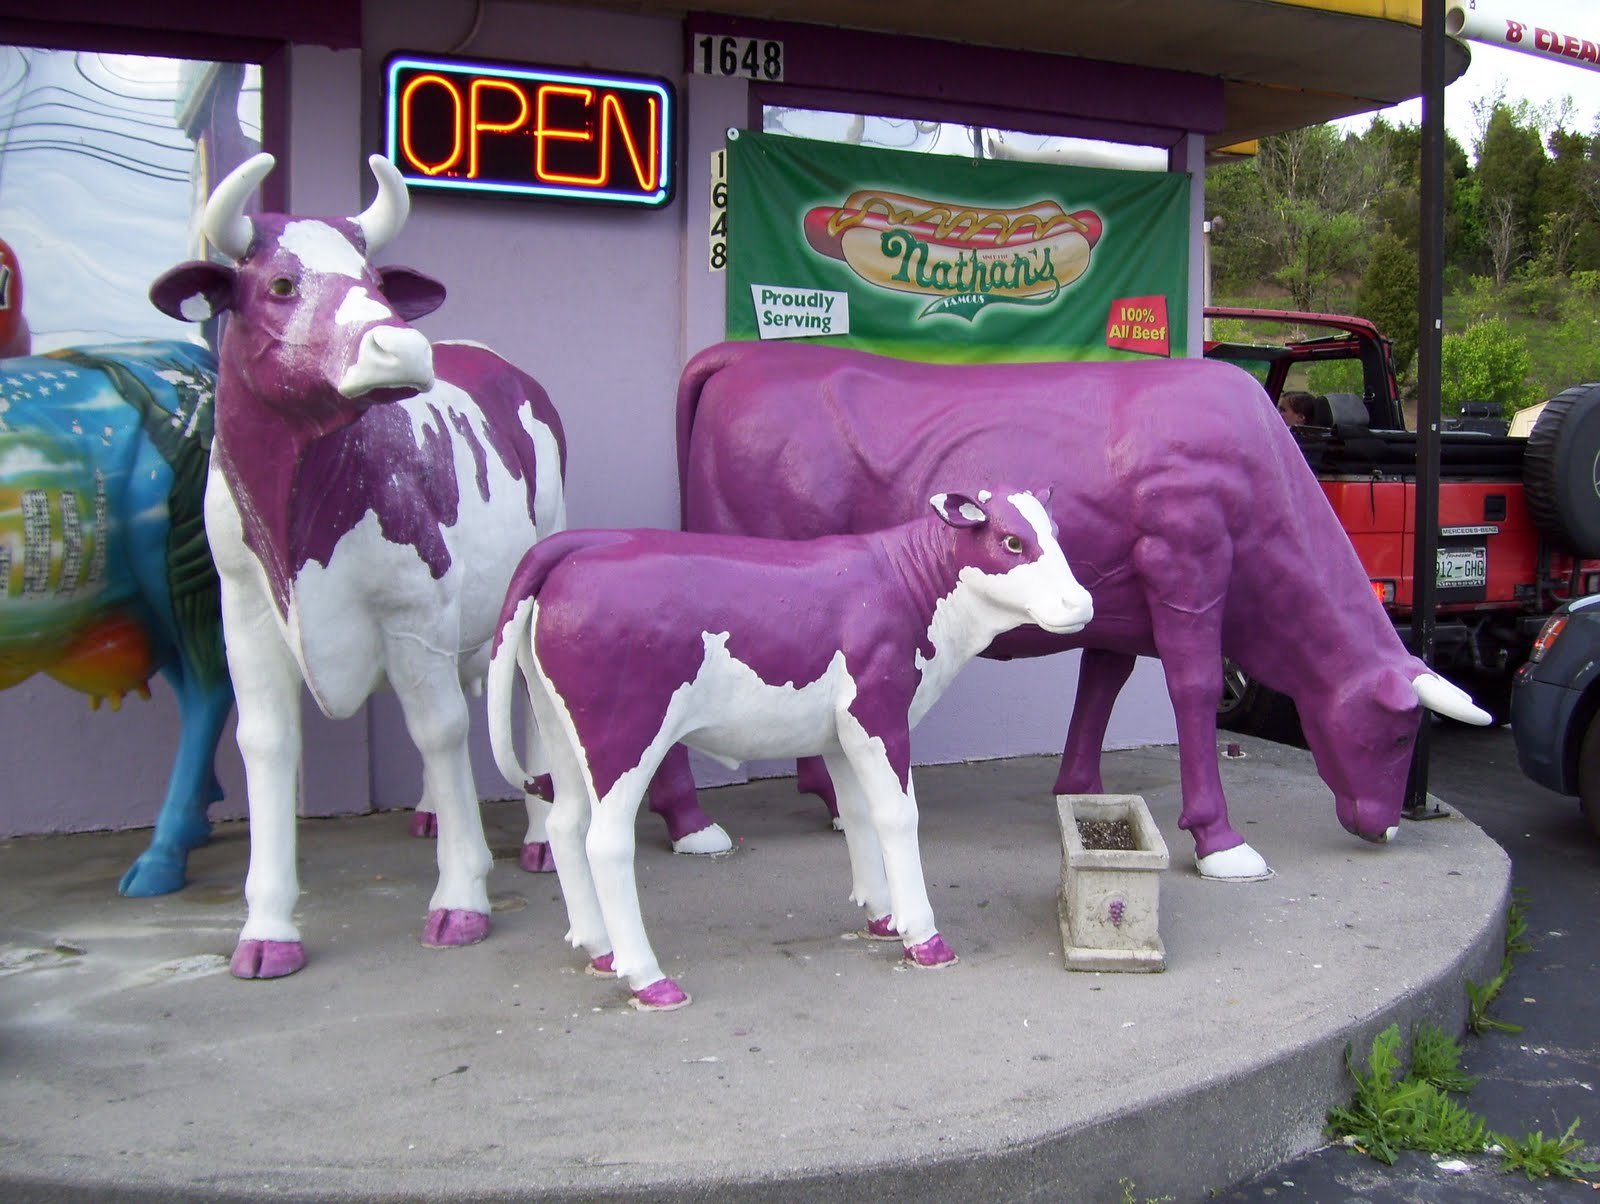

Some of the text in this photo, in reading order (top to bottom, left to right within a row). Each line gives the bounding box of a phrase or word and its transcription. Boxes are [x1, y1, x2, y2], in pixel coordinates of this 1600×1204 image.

[1534, 27, 1600, 64] CLEA
[699, 36, 781, 80] 1648
[402, 74, 657, 192] OPEN
[880, 229, 1060, 293] Nathan's
[761, 289, 835, 313] Proudly
[943, 294, 985, 308] FAMOUS
[763, 310, 832, 334] Serving
[1121, 307, 1155, 323] 100%
[1109, 324, 1166, 340] All Beef
[1442, 526, 1498, 535] MERCEDES-BENZ
